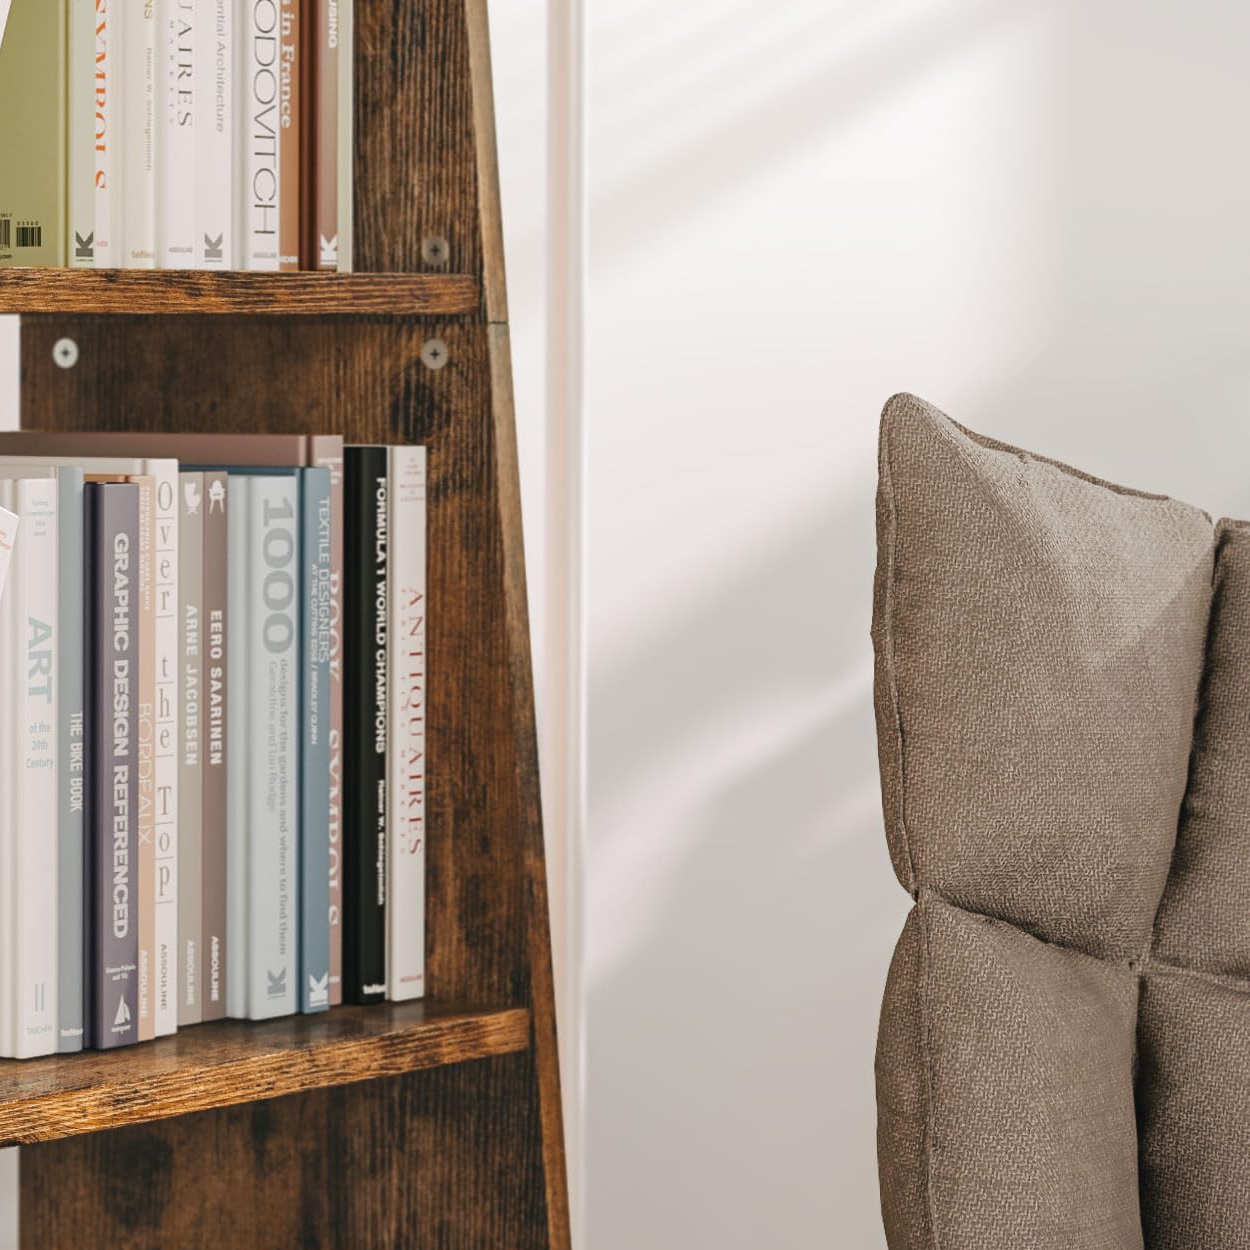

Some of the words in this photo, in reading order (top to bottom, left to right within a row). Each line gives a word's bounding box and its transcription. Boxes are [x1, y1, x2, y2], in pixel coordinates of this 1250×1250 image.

[281, 12, 295, 36] in
[215, 40, 226, 134] Architecture
[254, 0, 277, 235] ODOVITCH
[280, 44, 295, 129] France
[157, 481, 173, 611] Over
[318, 496, 330, 564] TEXTILE
[375, 477, 387, 563] FORMULA
[113, 532, 129, 652] GRAPHIC
[262, 496, 295, 655] 1000
[310, 563, 319, 576] AT
[310, 578, 319, 596] THE
[376, 567, 386, 576] 1
[185, 603, 199, 657] ARNE
[210, 609, 223, 660] EERO
[310, 598, 319, 637] CUTTING
[318, 568, 330, 663] DESIGNERS
[375, 580, 387, 646] WORLD
[28, 616, 52, 705] ART
[278, 657, 289, 707] designs
[29, 721, 38, 734] of
[70, 712, 83, 737] THE
[113, 659, 129, 757] DESIGN
[159, 655, 171, 750] the
[185, 664, 198, 766] JACOBSEN
[210, 666, 223, 765] SAARINEN
[278, 709, 289, 728] for
[375, 649, 386, 755] CHAMPIONS
[405, 586, 424, 855] ANTIQUAIRES
[25, 757, 54, 770] Century
[31, 738, 49, 751] 20th
[70, 742, 83, 772] BIKE
[278, 731, 289, 753] the
[70, 777, 83, 813] BOOK
[138, 703, 152, 848] BORDEAUX
[113, 764, 129, 939] REFERENCED
[157, 785, 172, 898] Top
[278, 809, 288, 833] and
[278, 835, 288, 876] where
[278, 878, 287, 892] to
[278, 894, 288, 920] find
[278, 922, 288, 955] them
[160, 943, 169, 1011] ASSOULINE
[211, 935, 219, 1002] ASSOULINE
